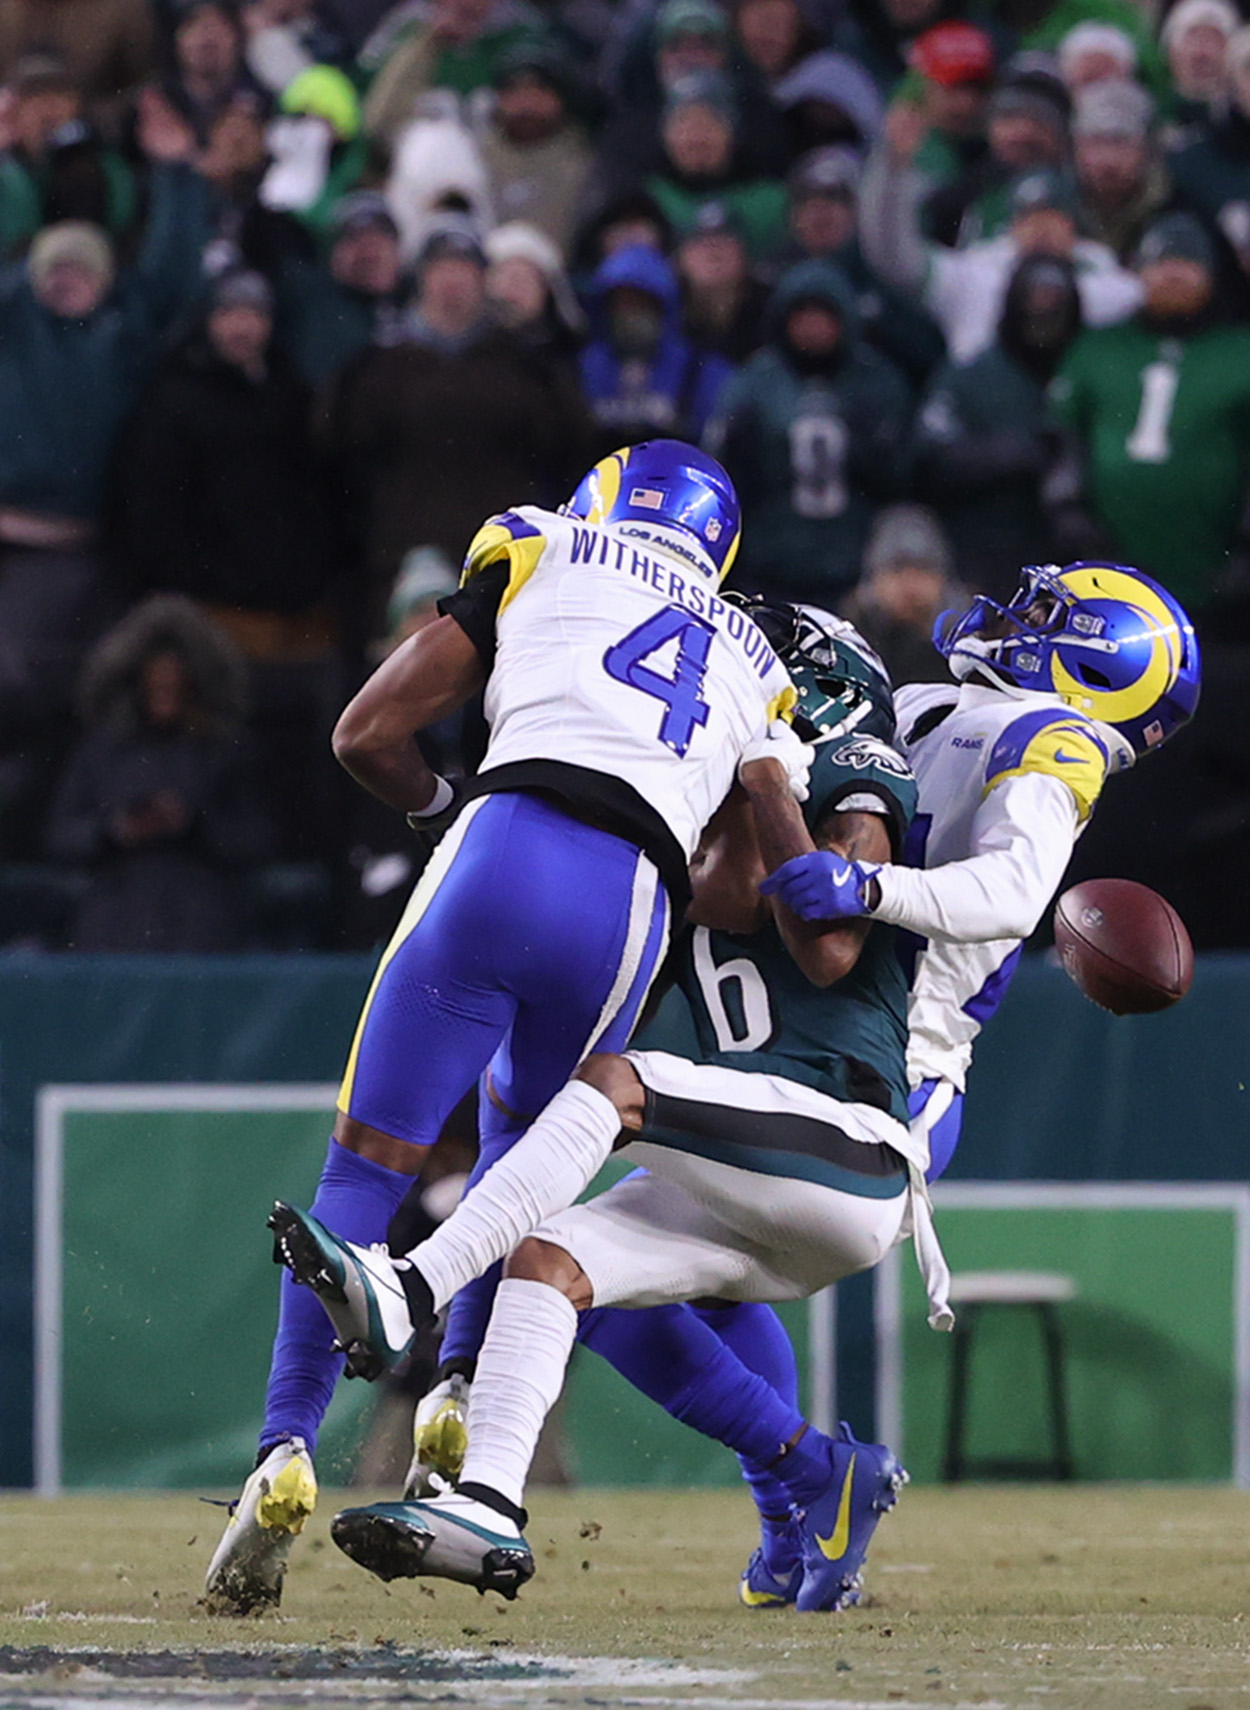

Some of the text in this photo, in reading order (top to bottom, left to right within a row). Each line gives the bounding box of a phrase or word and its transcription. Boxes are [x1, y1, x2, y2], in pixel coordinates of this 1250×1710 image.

[1126, 361, 1180, 464] 1
[570, 526, 777, 680] WITHERSPOON
[619, 526, 714, 579] LOS ANGELES
[602, 602, 718, 760] 4
[693, 924, 773, 1053] 6
